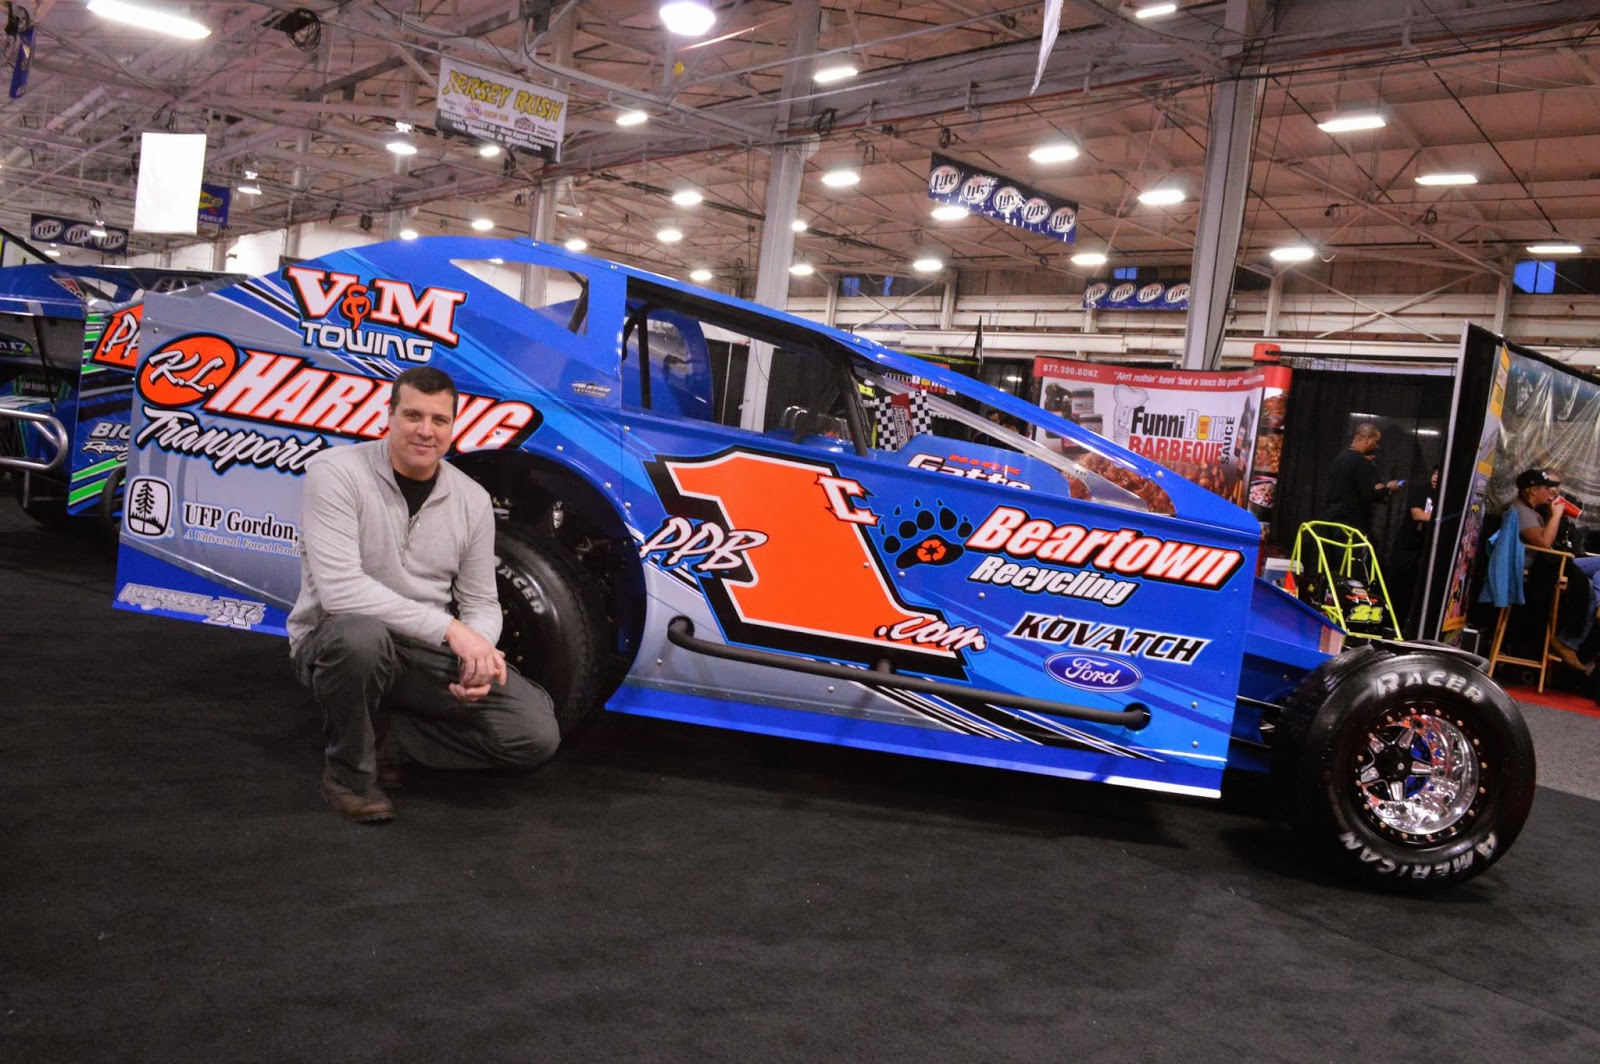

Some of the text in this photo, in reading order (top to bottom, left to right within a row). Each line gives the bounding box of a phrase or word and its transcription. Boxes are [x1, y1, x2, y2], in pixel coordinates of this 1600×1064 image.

[442, 69, 514, 108] JERSEY
[512, 89, 563, 122] RUSH
[934, 172, 956, 190] Lite
[1026, 205, 1047, 220] Lite
[1054, 213, 1075, 230] Lite
[285, 265, 467, 346] V&M
[300, 320, 434, 363] TOWING
[203, 349, 536, 455] HARRNG
[1128, 435, 1223, 465] BARBEQUE
[1221, 416, 1236, 465] SAUCE
[184, 530, 193, 540] A
[195, 531, 241, 547] Universal
[242, 538, 273, 552] Forest
[185, 503, 299, 545] UFP Gordon,
[964, 505, 1246, 588] Beartown
[969, 555, 1138, 606] Recycling
[1347, 603, 1383, 622] 21
[1010, 612, 1207, 663] KOVATCH
[1064, 657, 1122, 685] Ford
[1375, 670, 1486, 702] RACER
[1338, 830, 1498, 880] AMERICAN
